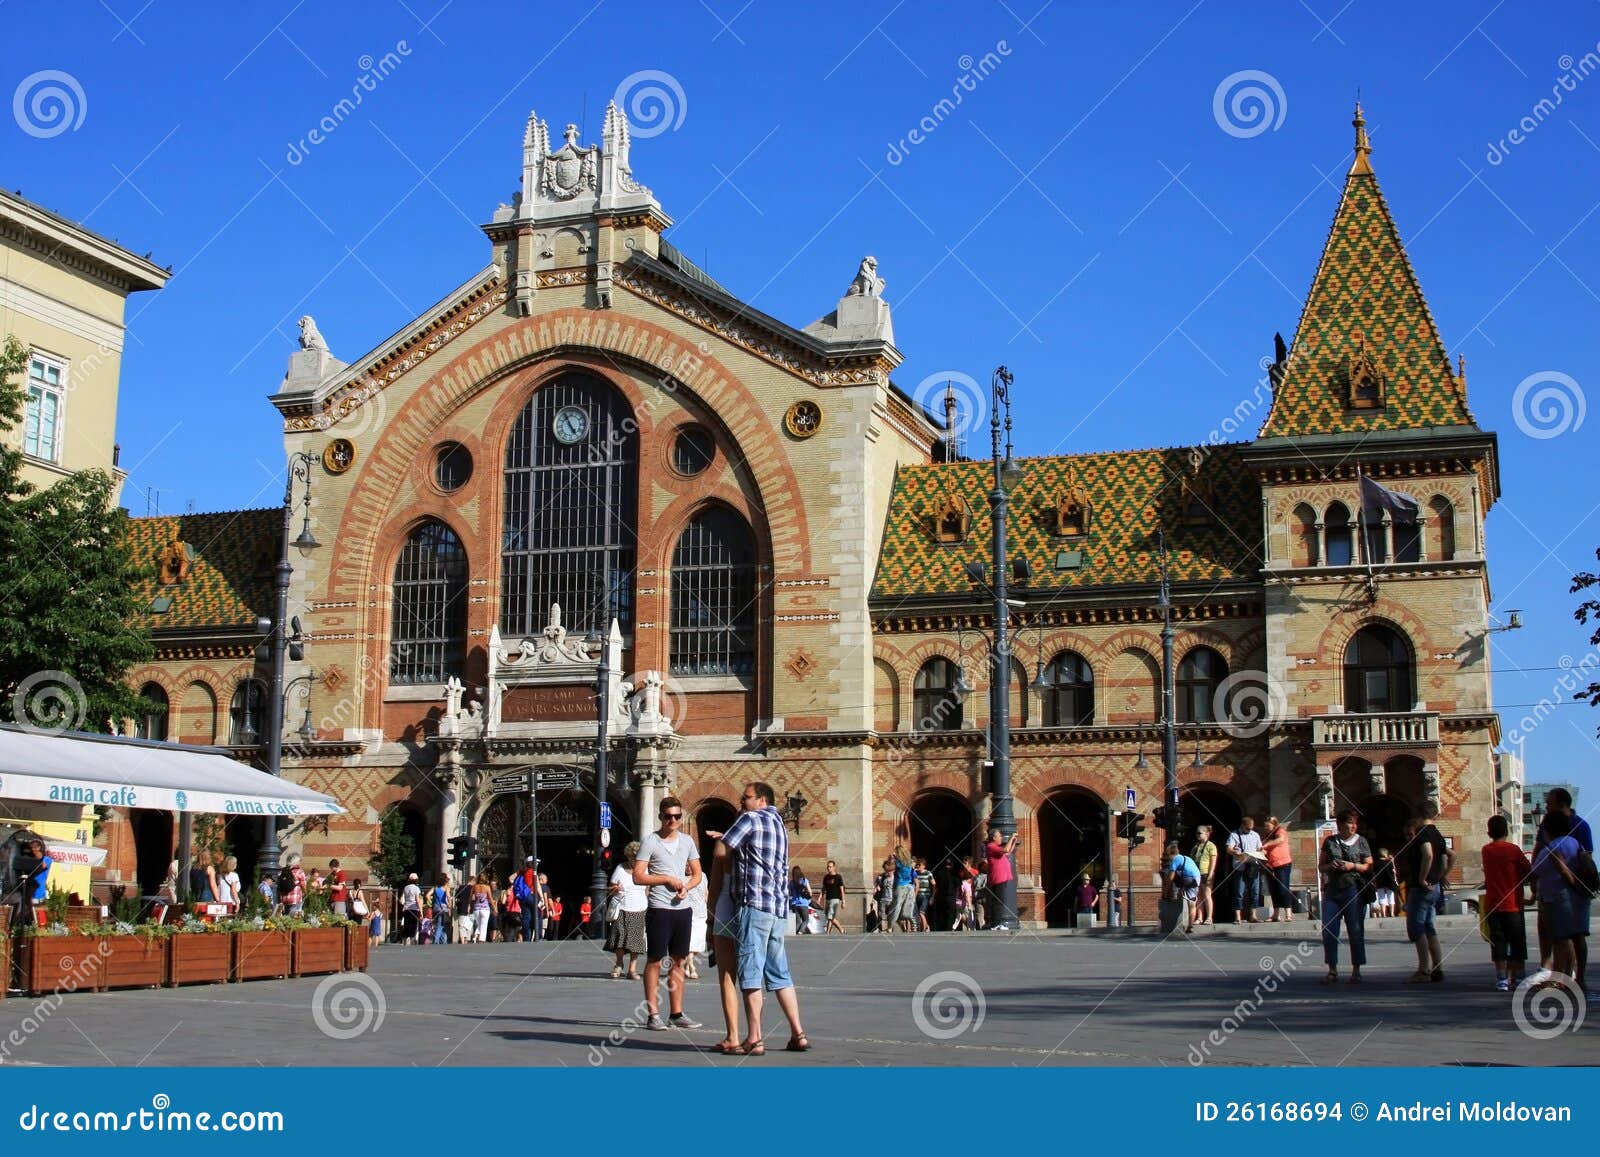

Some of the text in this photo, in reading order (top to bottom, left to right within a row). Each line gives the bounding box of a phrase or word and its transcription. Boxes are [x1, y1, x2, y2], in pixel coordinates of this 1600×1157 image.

[49, 785, 137, 806] anna café
[225, 799, 297, 815] anna café
[68, 852, 89, 863] KING
